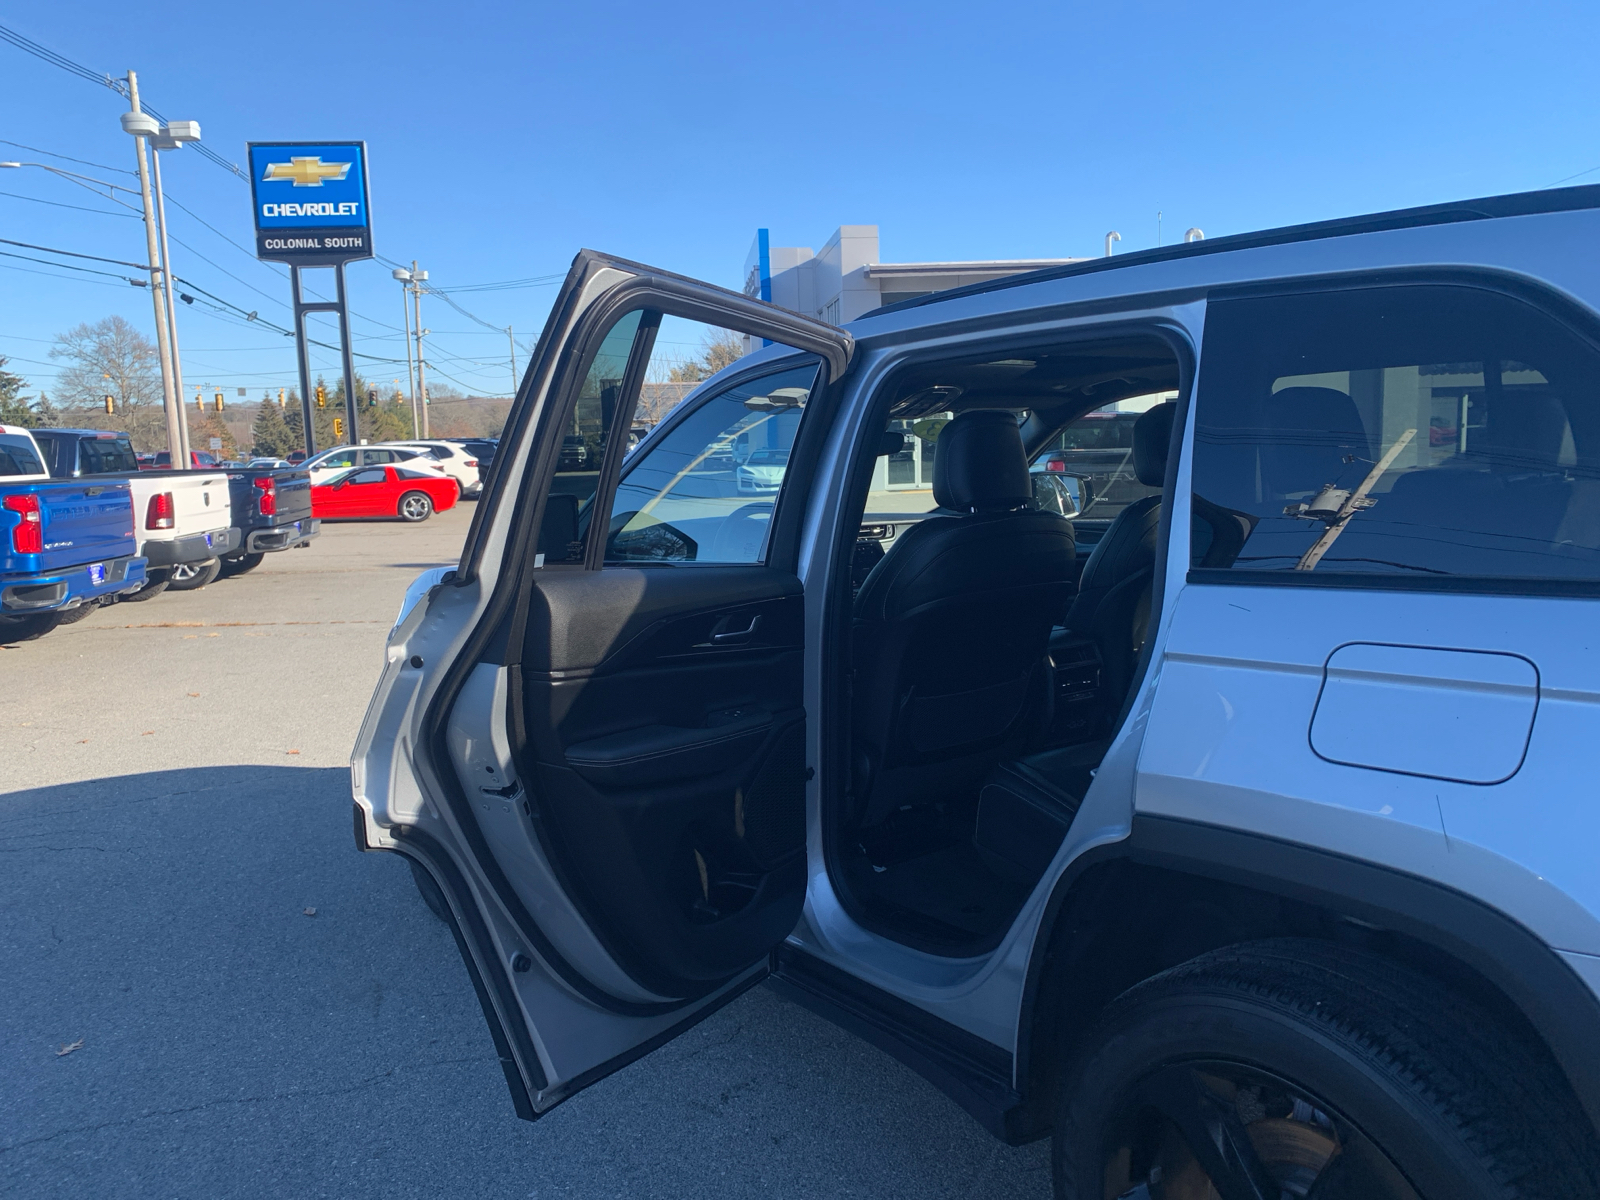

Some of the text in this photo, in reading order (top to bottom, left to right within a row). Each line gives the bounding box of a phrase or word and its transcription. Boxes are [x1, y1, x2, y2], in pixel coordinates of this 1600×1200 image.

[263, 203, 359, 217] CHEVROLET
[265, 238, 362, 249] COLONIAL SOUTH
